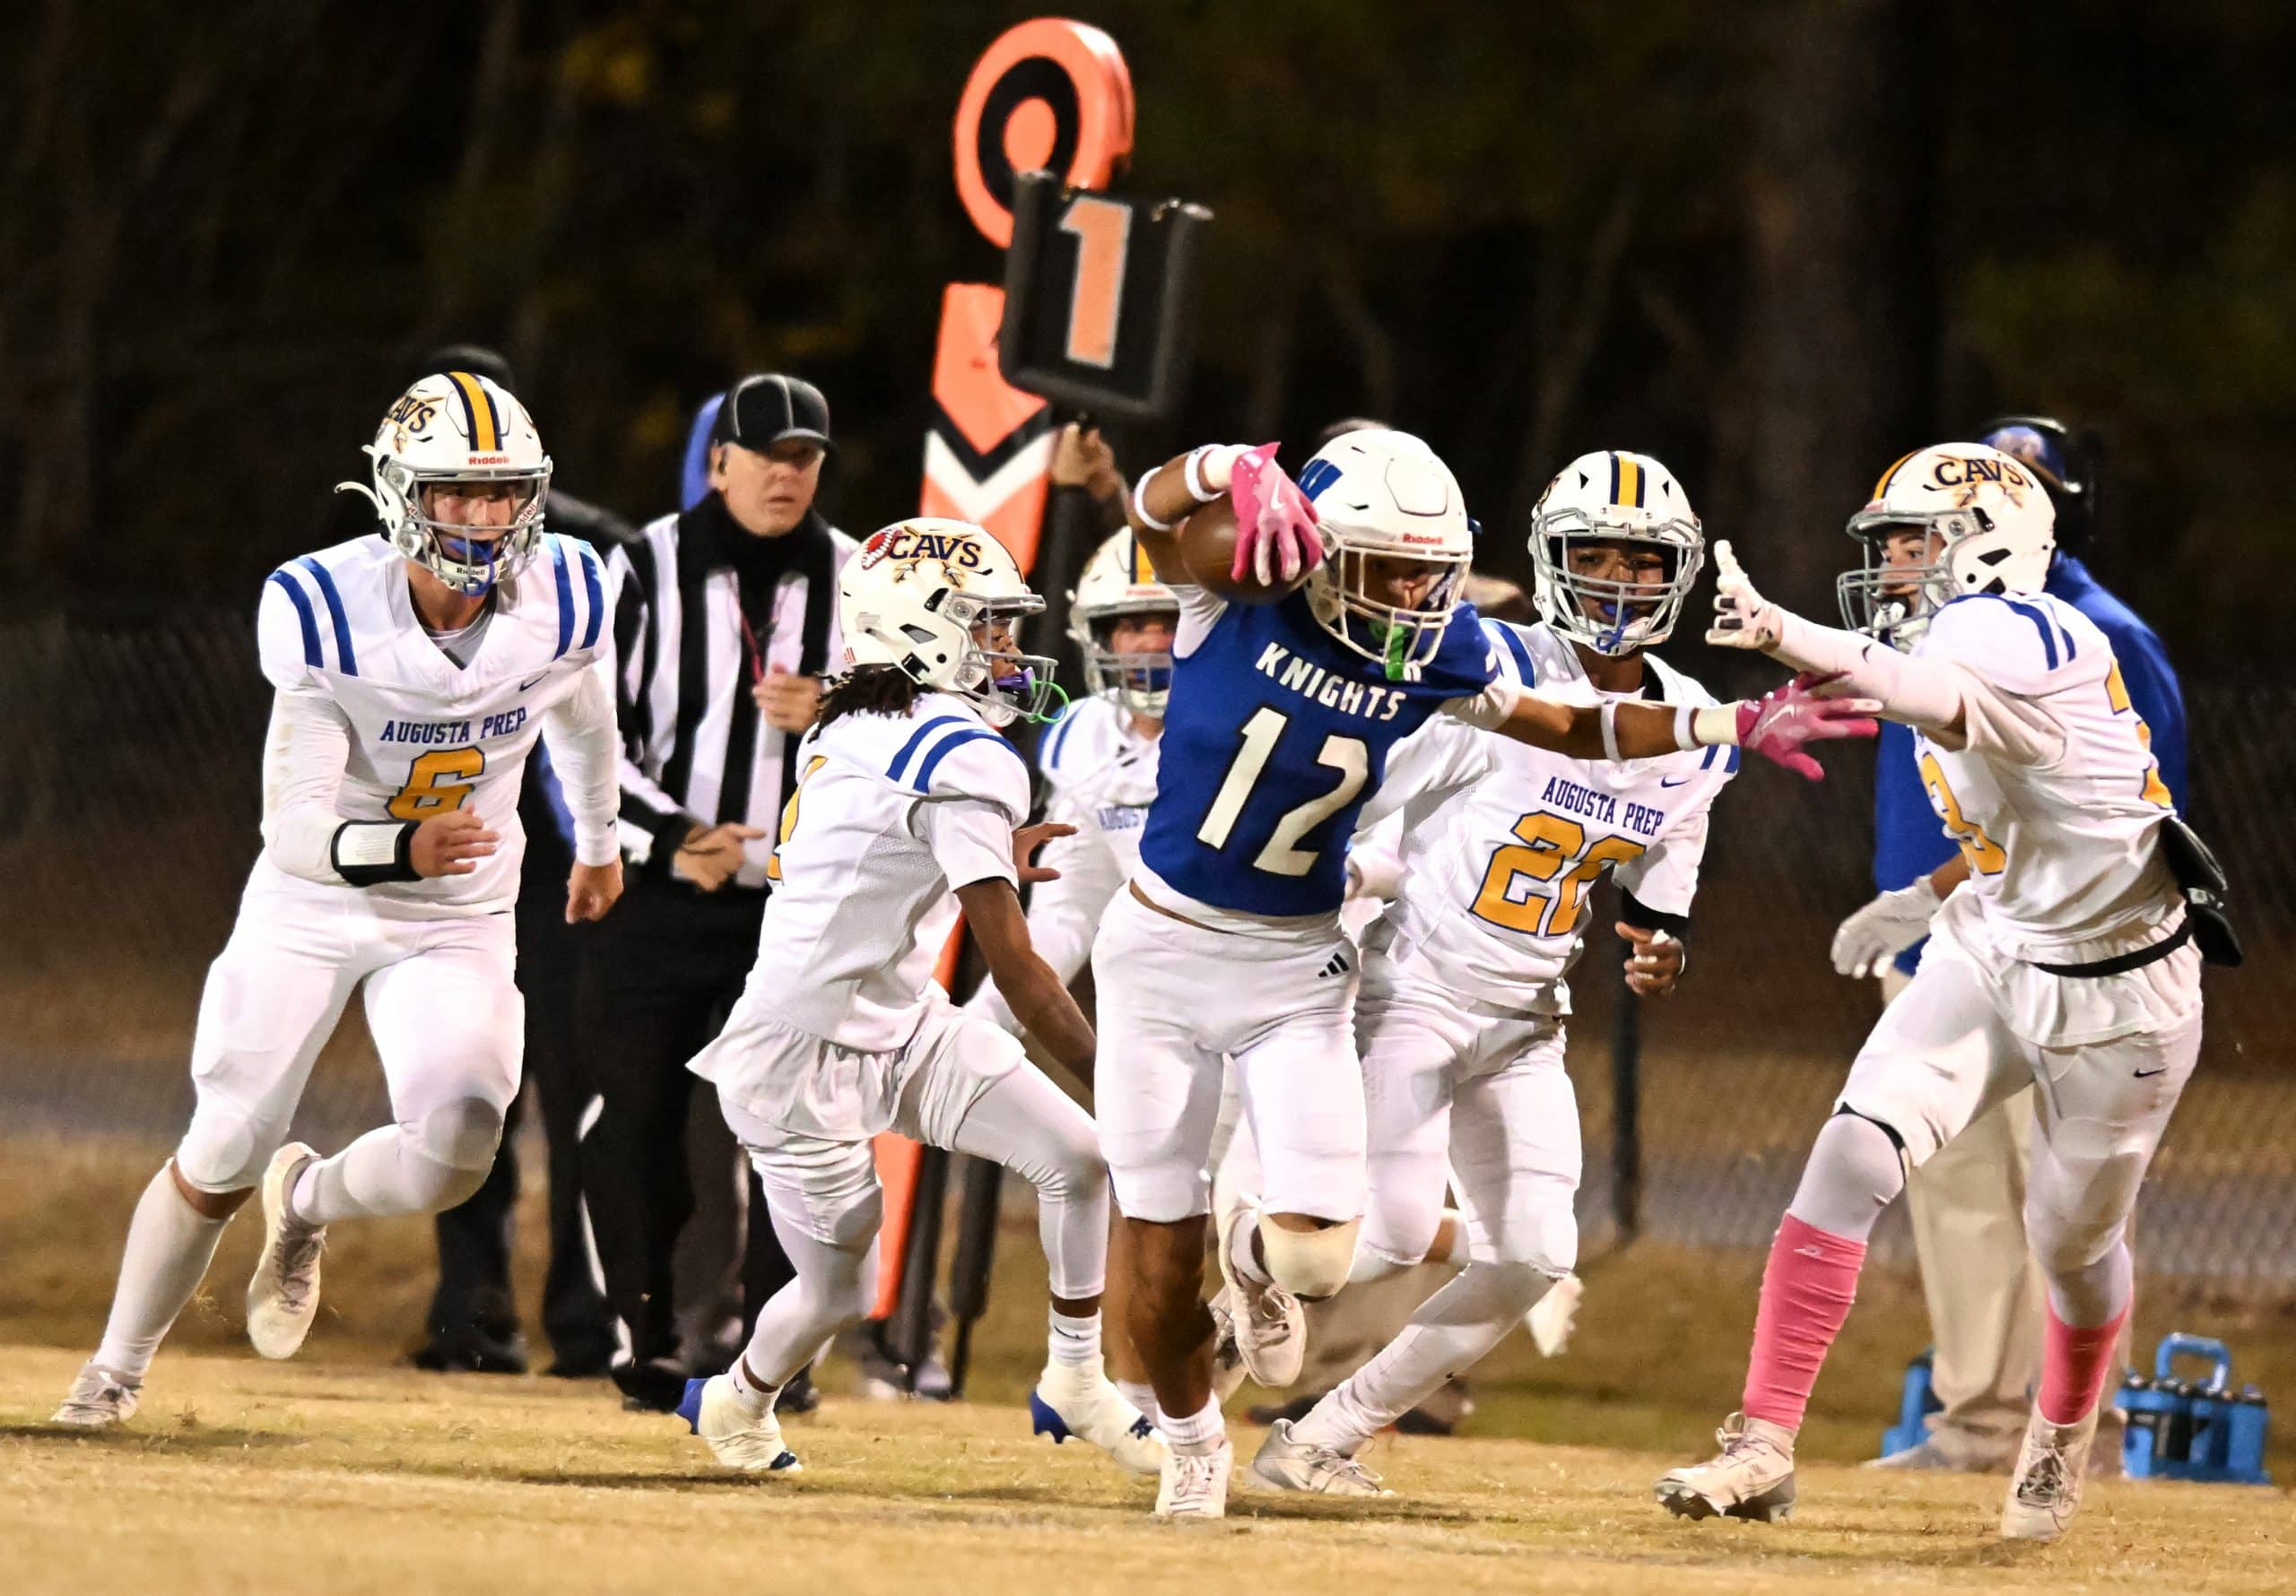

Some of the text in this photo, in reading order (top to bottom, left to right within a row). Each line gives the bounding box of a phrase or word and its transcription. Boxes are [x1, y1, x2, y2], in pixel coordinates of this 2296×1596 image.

[1058, 195, 1134, 371] 1
[387, 395, 436, 433] AVS
[1934, 459, 2024, 486] CAVS
[888, 534, 982, 568] CAVS
[1255, 641, 1407, 721] KNIGHTS
[379, 707, 527, 744] AUGUSTA PREP
[383, 745, 486, 821] 6
[1196, 707, 1369, 877] 12
[1541, 776, 1665, 837] AUGUSTA PREP
